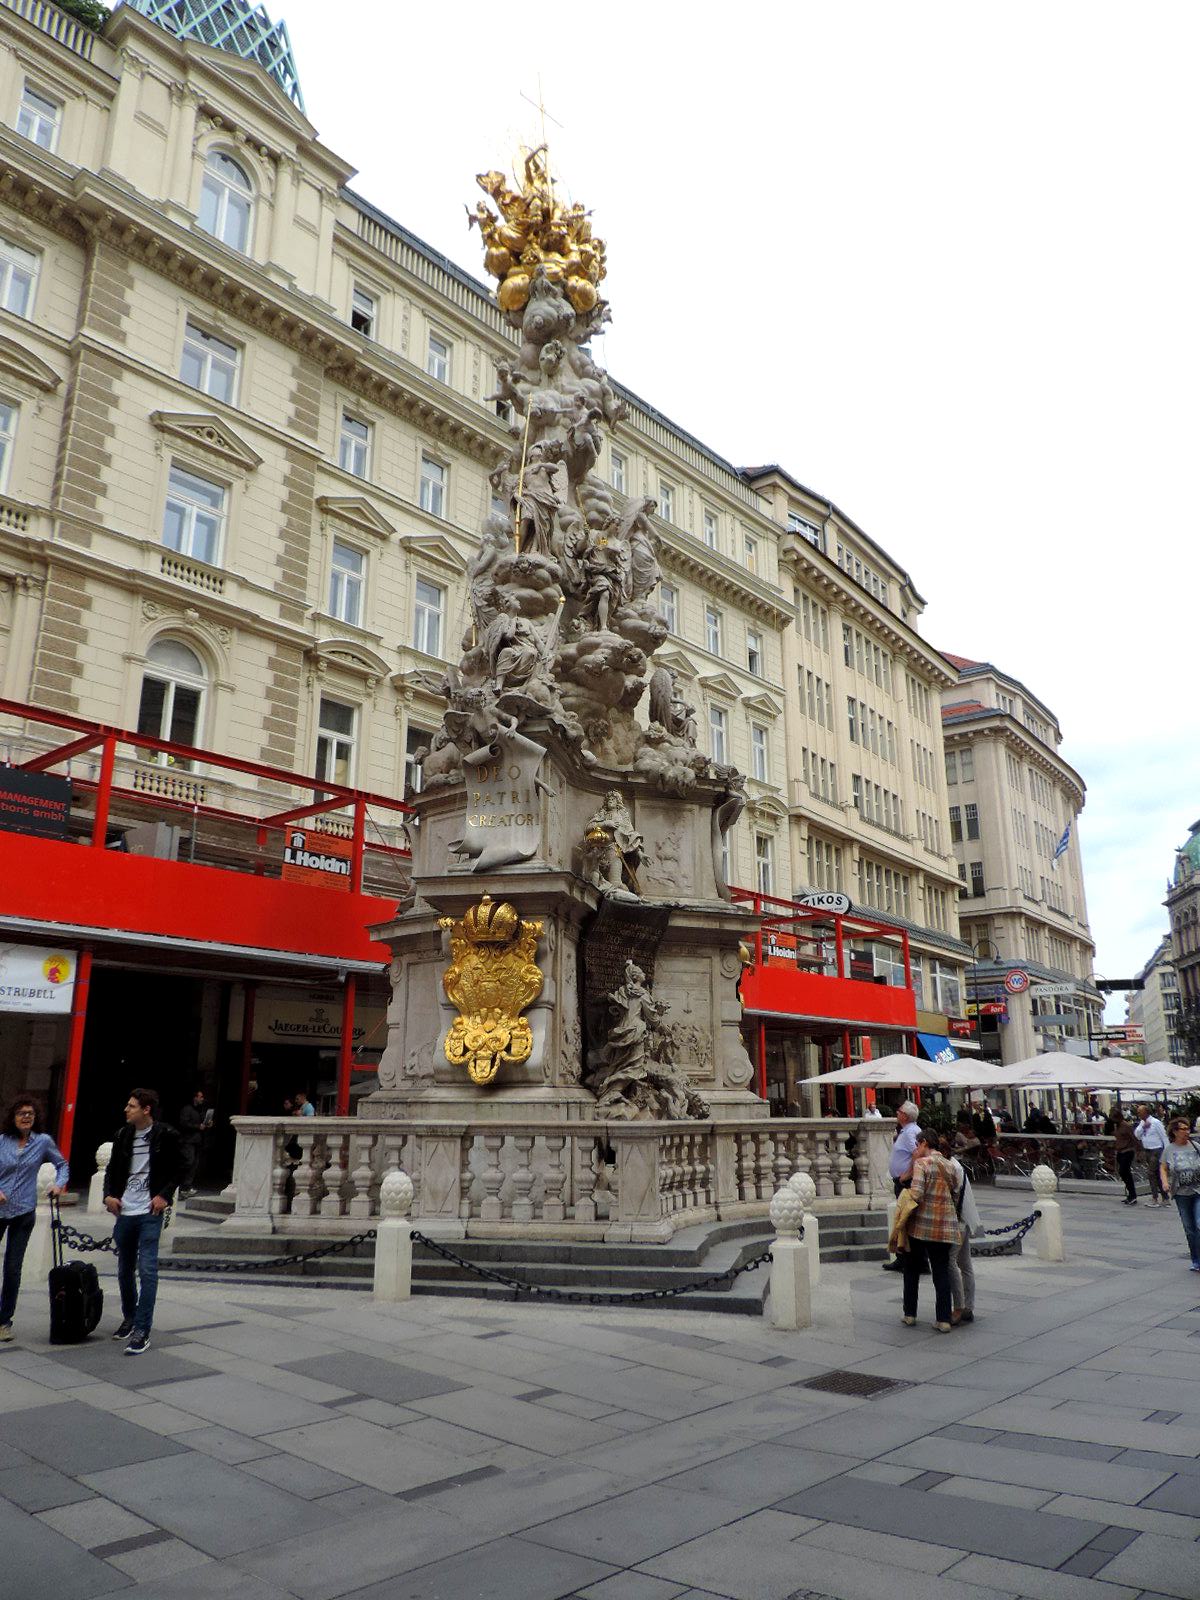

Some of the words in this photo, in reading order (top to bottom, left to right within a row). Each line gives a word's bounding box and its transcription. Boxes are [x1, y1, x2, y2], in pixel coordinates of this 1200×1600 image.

[477, 765, 521, 784] DEO
[0, 791, 65, 811] MANAGEMENT
[473, 789, 530, 808] PATRI
[468, 813, 540, 828] CREATORI
